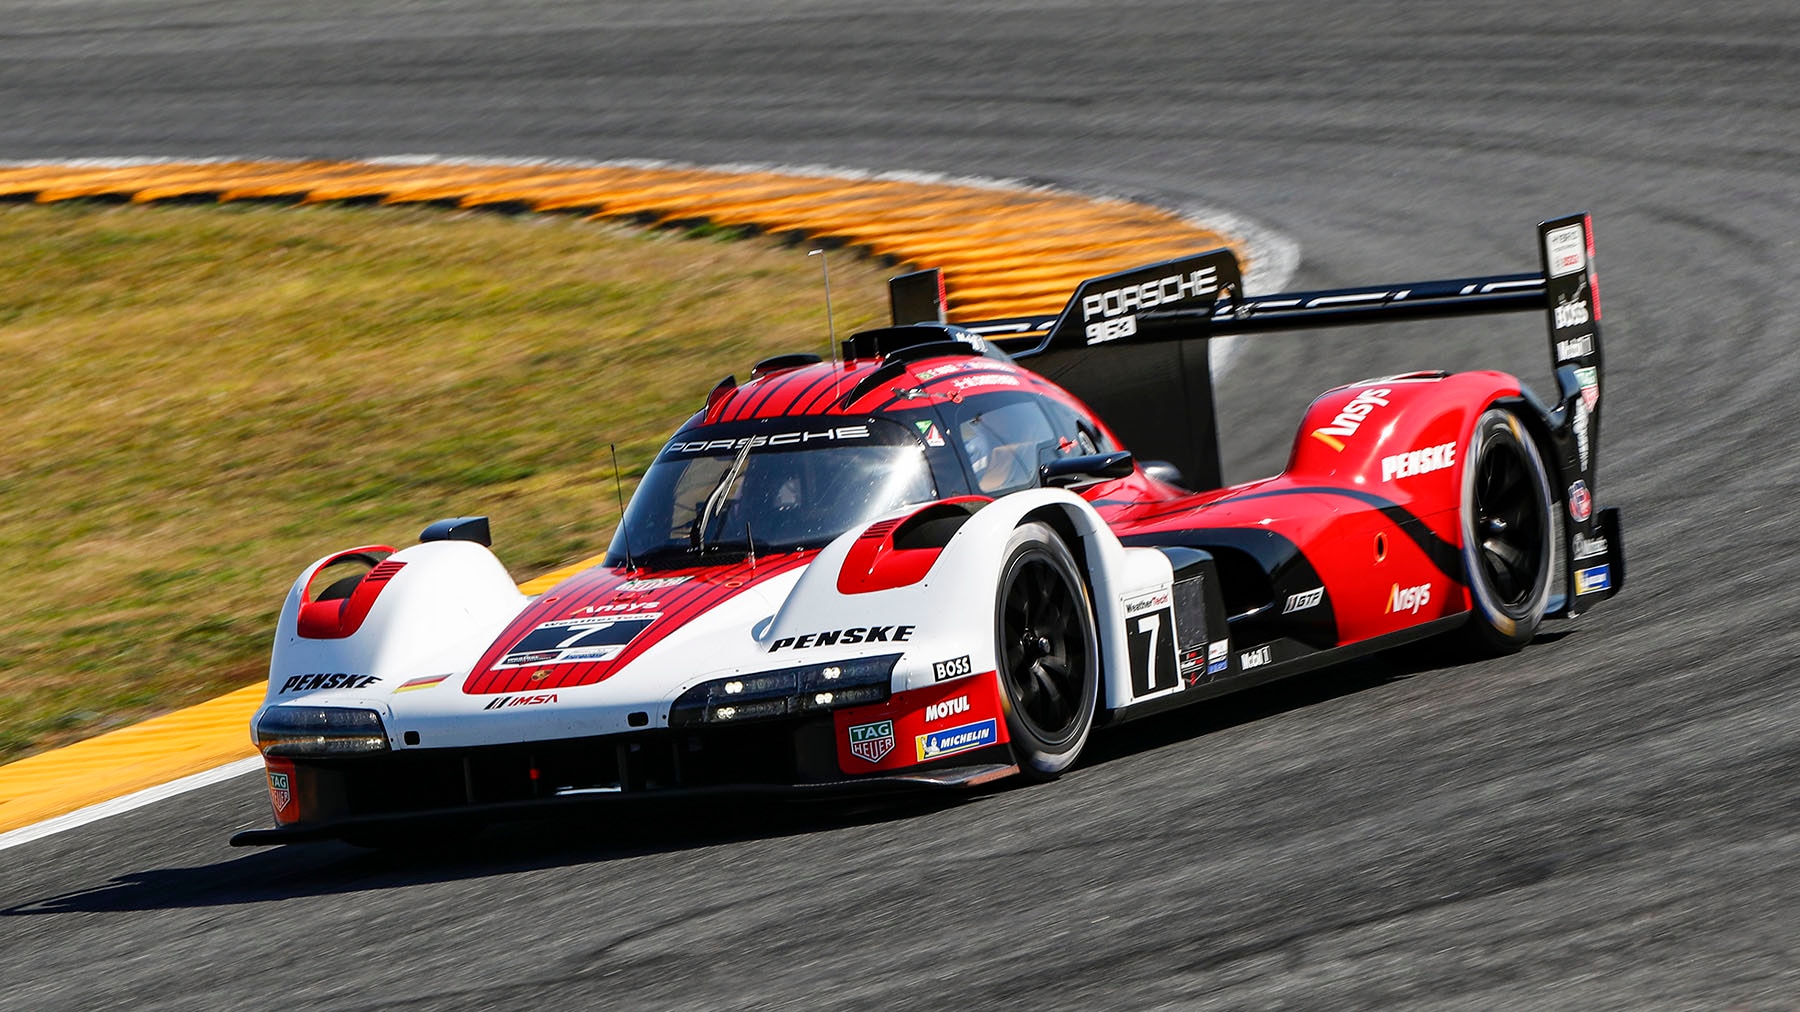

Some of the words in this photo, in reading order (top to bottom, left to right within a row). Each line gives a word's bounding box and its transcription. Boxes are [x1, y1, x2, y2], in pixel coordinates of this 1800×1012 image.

[1083, 266, 1218, 322] PORSCHE
[1085, 315, 1137, 345] 963
[1311, 388, 1392, 452] Ansys
[665, 425, 870, 455] PORSCHE
[1381, 441, 1457, 482] PENSKE
[569, 602, 660, 615] Ansys
[1384, 583, 1431, 614] Ansys
[556, 623, 615, 649] 7
[768, 625, 915, 653] PENSKE
[1138, 613, 1160, 690] 7
[936, 657, 970, 679] BOSS
[279, 673, 383, 695] PENSKE
[508, 694, 558, 707] IMSA
[926, 696, 970, 722] MOTUL
[853, 724, 890, 741] TAG
[941, 728, 990, 749] MICHELIN
[854, 739, 892, 760] HEUER
[270, 775, 287, 788] TAG
